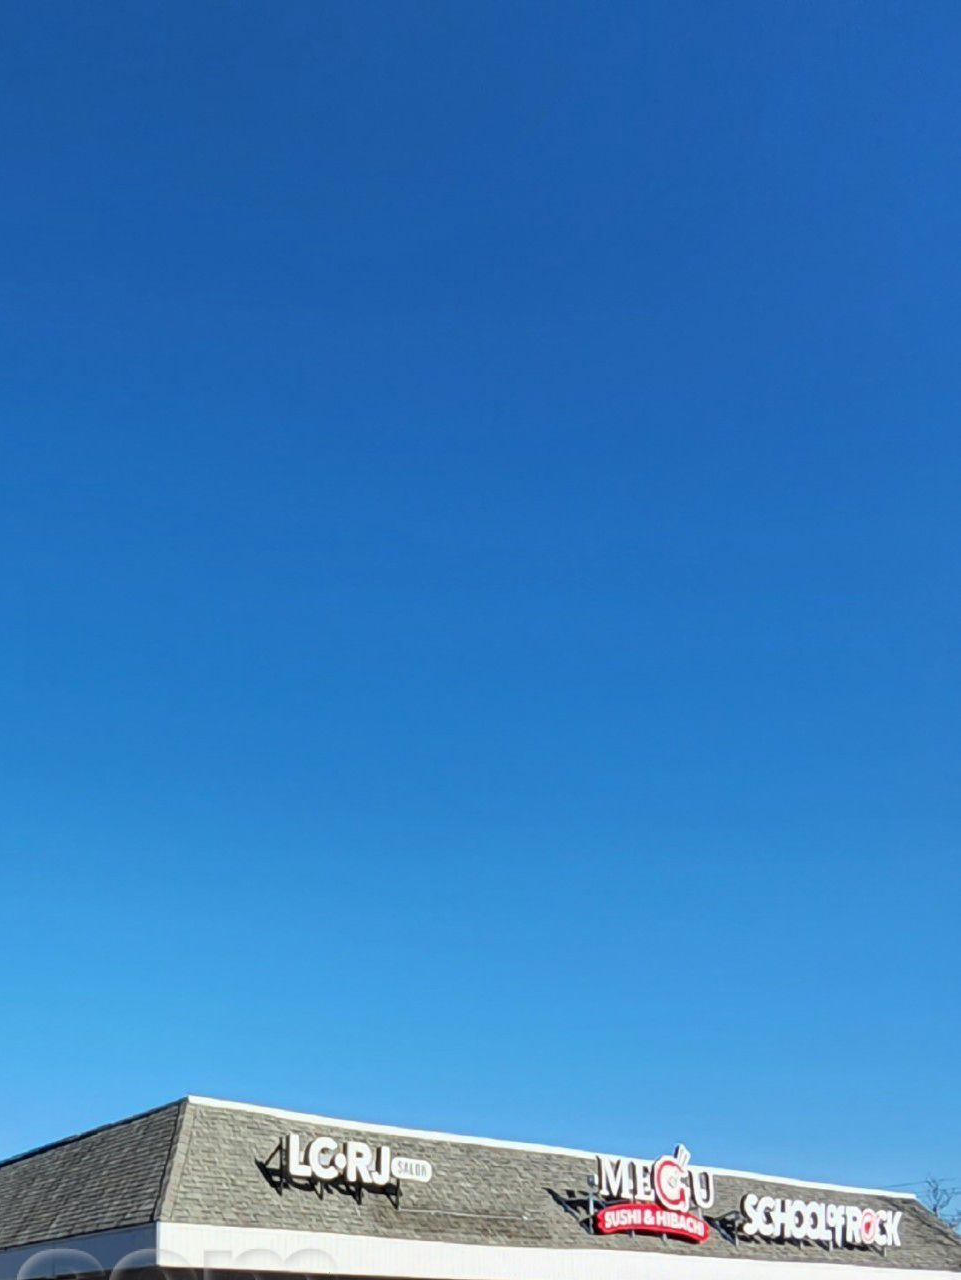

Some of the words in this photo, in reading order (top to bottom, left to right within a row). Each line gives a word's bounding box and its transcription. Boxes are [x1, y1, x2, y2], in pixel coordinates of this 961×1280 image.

[597, 1143, 715, 1213] MEGU
[604, 1209, 642, 1229] SUSHI
[643, 1208, 655, 1225] &
[655, 1210, 706, 1238] HIBACHI
[743, 1193, 832, 1242] SCHOOL
[845, 1205, 903, 1247] ROCK
